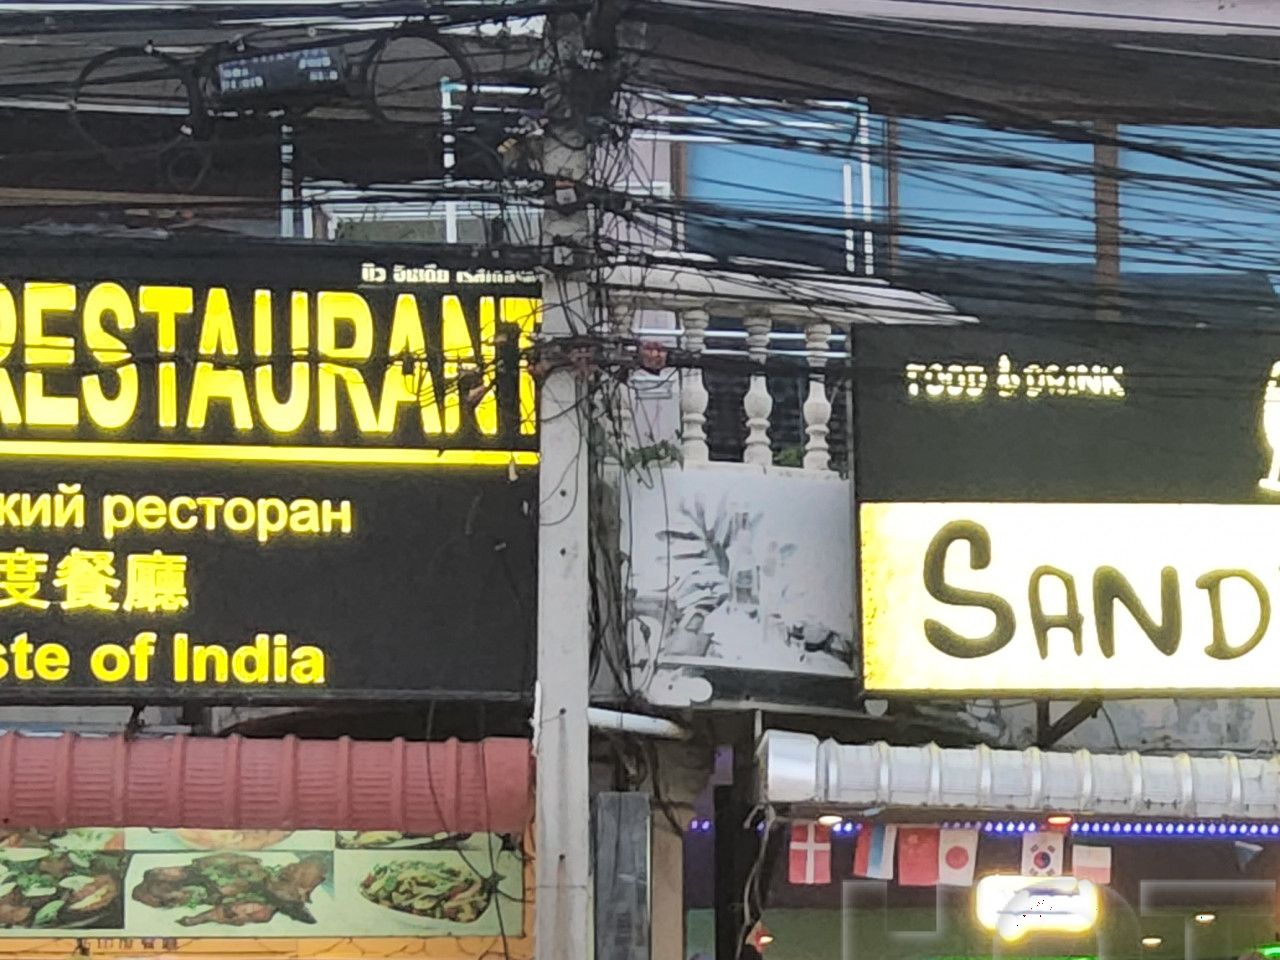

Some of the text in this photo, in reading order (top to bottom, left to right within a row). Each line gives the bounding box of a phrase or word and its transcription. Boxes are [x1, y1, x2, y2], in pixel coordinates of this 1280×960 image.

[906, 363, 988, 397] FOOD
[1023, 364, 1126, 398] DRINK
[102, 492, 352, 541] ресторан
[0, 631, 326, 684] te of India
